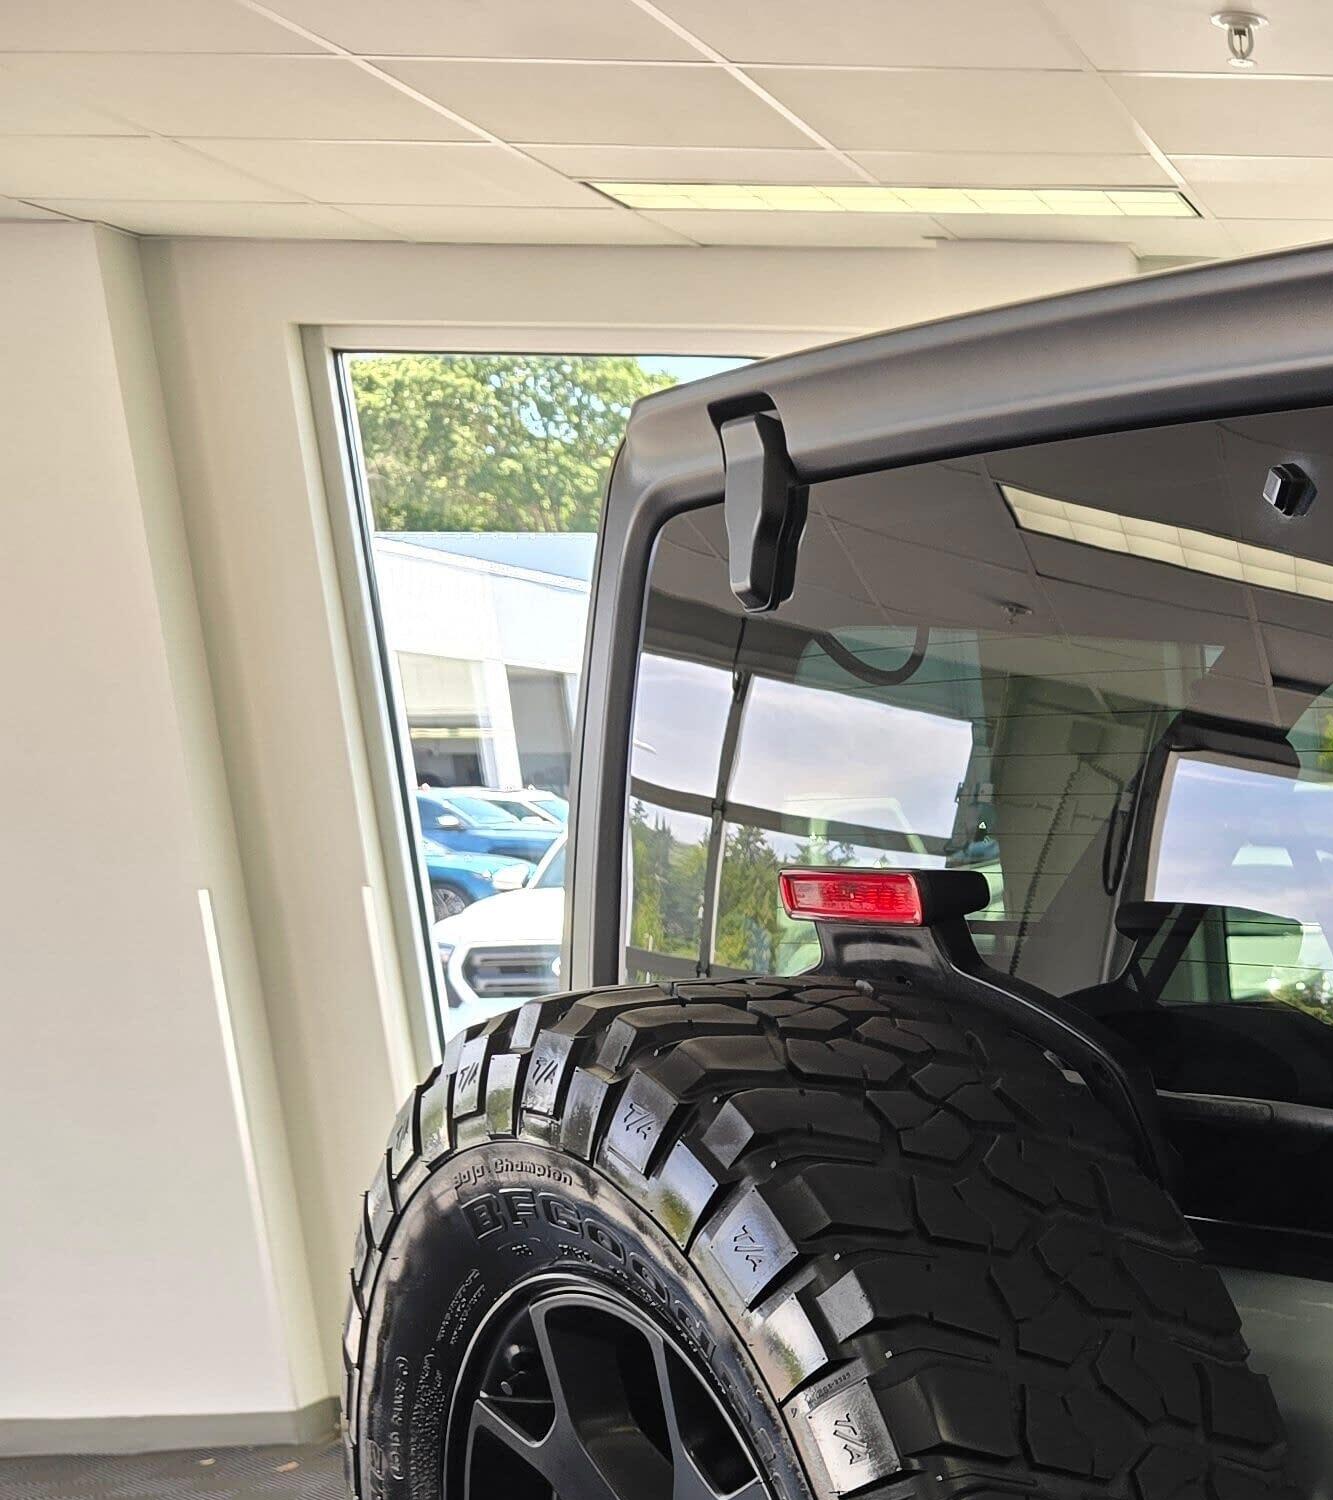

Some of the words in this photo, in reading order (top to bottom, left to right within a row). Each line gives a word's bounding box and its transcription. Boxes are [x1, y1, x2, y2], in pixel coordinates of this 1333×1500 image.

[459, 1062, 478, 1093] T/A
[532, 1056, 558, 1086] T/A
[622, 1101, 655, 1140] T/A
[494, 1158, 573, 1186] Champion
[733, 1224, 764, 1272] T/A
[833, 1412, 867, 1465] T/A
